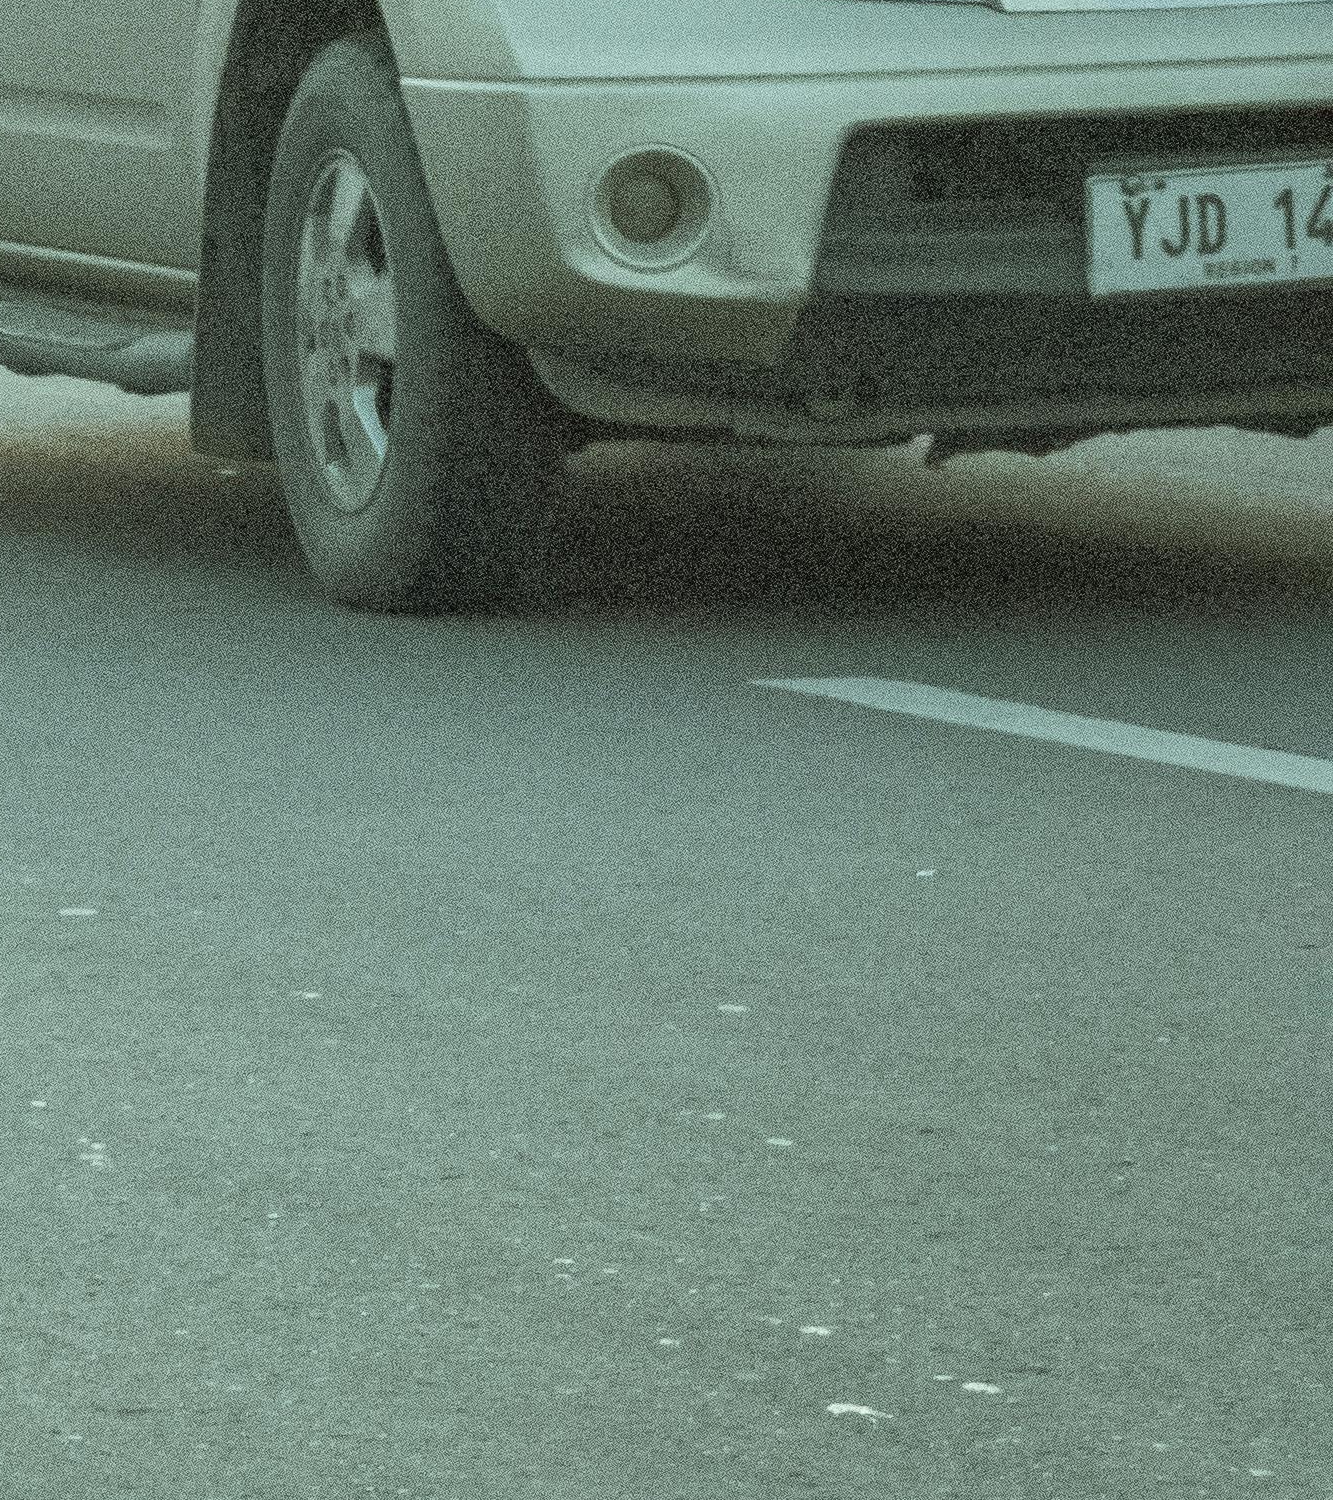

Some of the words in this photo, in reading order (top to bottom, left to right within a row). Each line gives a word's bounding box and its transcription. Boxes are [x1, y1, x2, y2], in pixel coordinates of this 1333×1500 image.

[1121, 193, 1228, 261] YJD
[1273, 186, 1333, 250] 14
[1202, 256, 1277, 279] REGION
